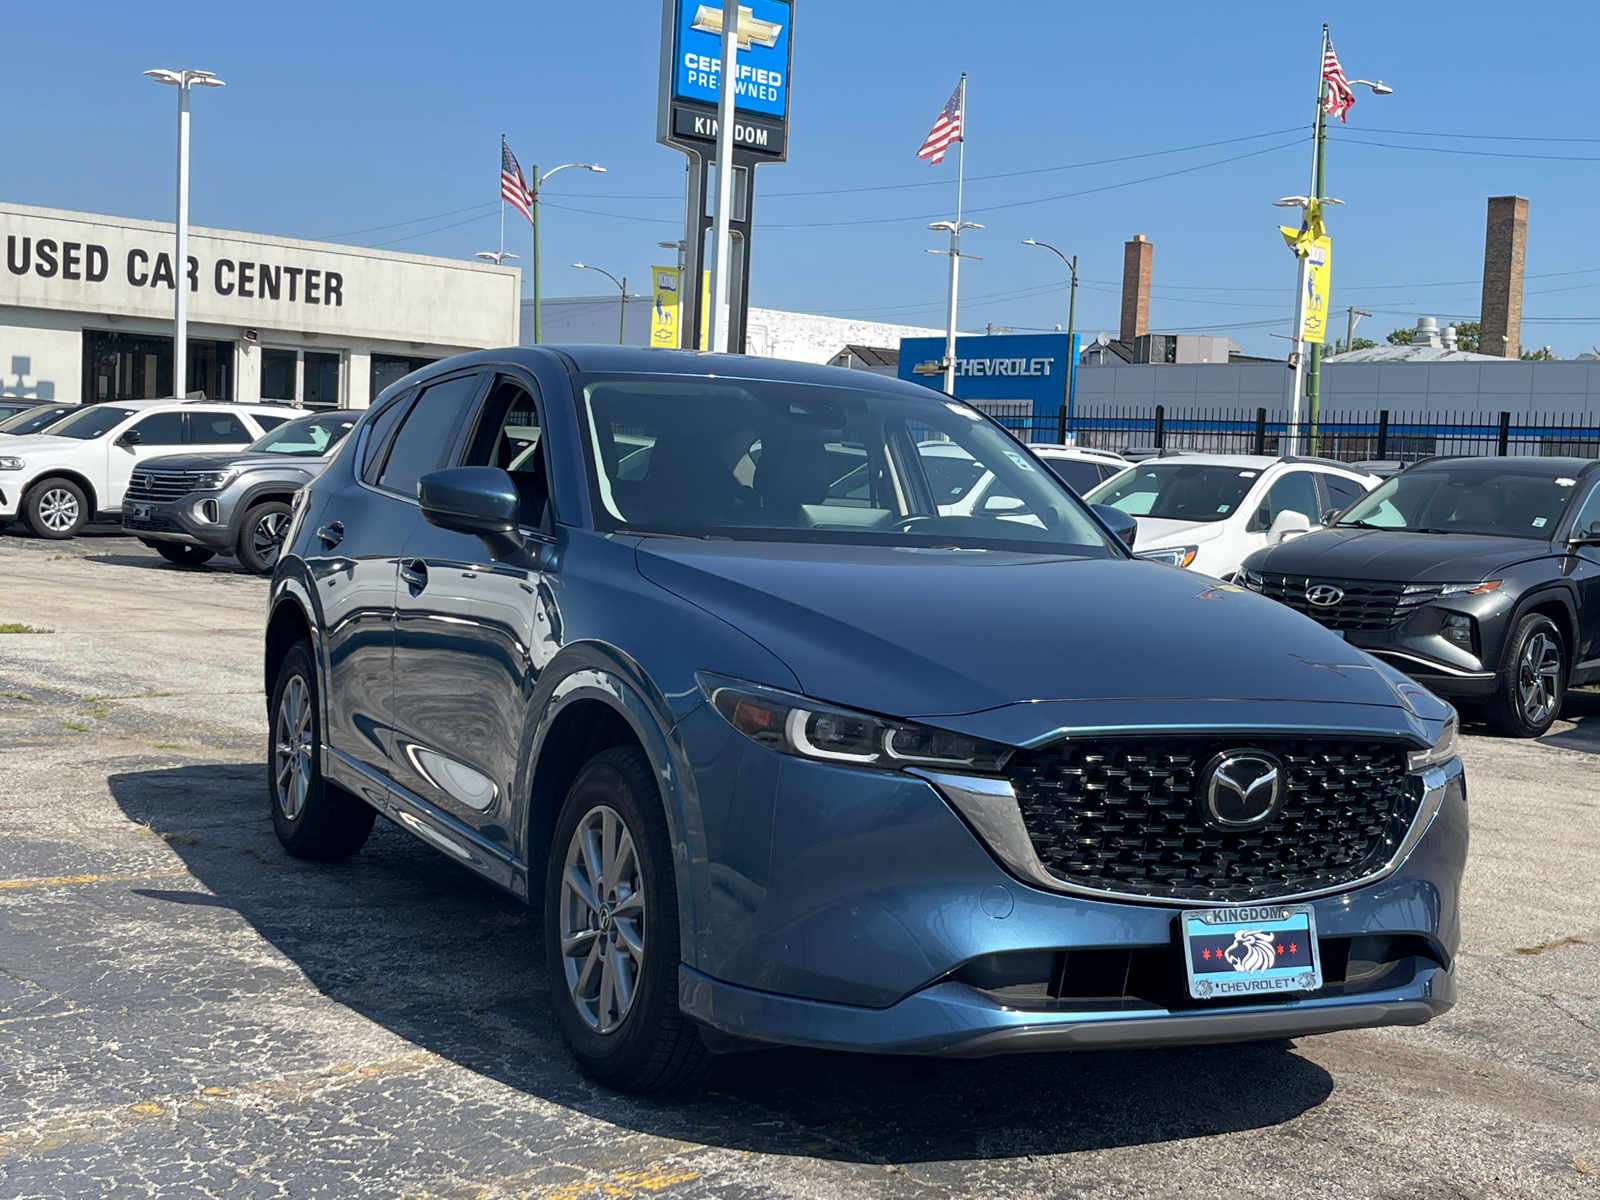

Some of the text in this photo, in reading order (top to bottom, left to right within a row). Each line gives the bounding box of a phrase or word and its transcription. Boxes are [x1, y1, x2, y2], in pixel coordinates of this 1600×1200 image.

[685, 53, 782, 87] CERIFIED
[688, 70, 778, 102] PRE-WNED
[695, 116, 768, 146] KINDOM
[7, 234, 344, 307] USED CAR CENTER
[1213, 907, 1282, 923] KINGDOM
[1220, 978, 1290, 993] CHEVROLET
